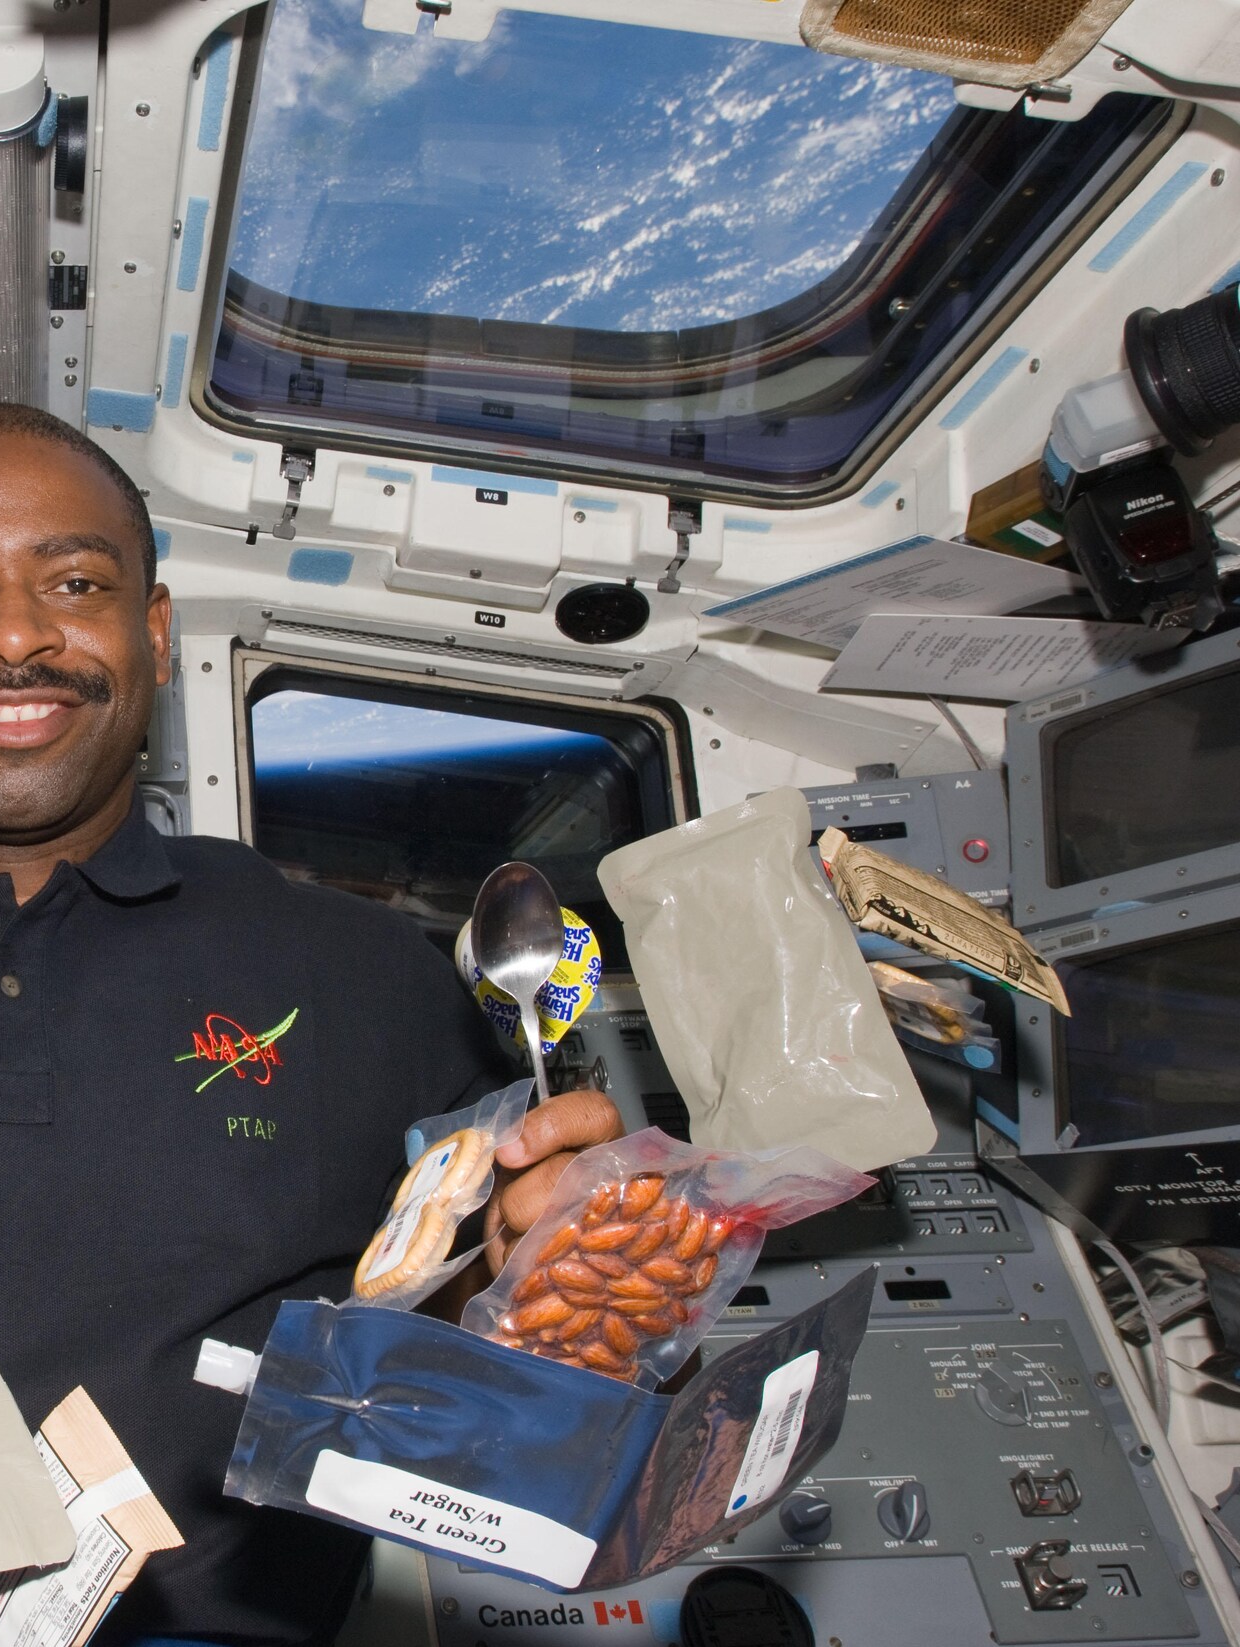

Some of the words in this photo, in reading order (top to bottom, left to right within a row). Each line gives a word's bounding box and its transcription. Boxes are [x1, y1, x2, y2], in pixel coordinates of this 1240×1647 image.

[483, 491, 499, 501] W8
[1126, 493, 1164, 511] Nikon
[480, 614, 500, 624] W10
[955, 780, 972, 790] A4
[817, 795, 850, 805] MISSION
[852, 793, 870, 801] TIME
[1196, 1166, 1224, 1175] AFT
[1114, 1184, 1151, 1192] CCTV
[1157, 1180, 1228, 1190] MONITOR
[971, 1343, 996, 1351] JOINT
[935, 1389, 954, 1397] 1/S1
[999, 1454, 1054, 1462] SINGLE/DIRECT
[409, 1491, 501, 1527] w/Sugar
[389, 1508, 428, 1533] Tea
[90, 1532, 106, 1551] Calories
[436, 1524, 506, 1554] Green
[704, 1546, 718, 1554] VAR
[1090, 1543, 1128, 1552] RELEASE
[94, 1547, 121, 1583] Nutrition
[81, 1582, 97, 1605] Facts
[478, 1603, 584, 1628] Canada
